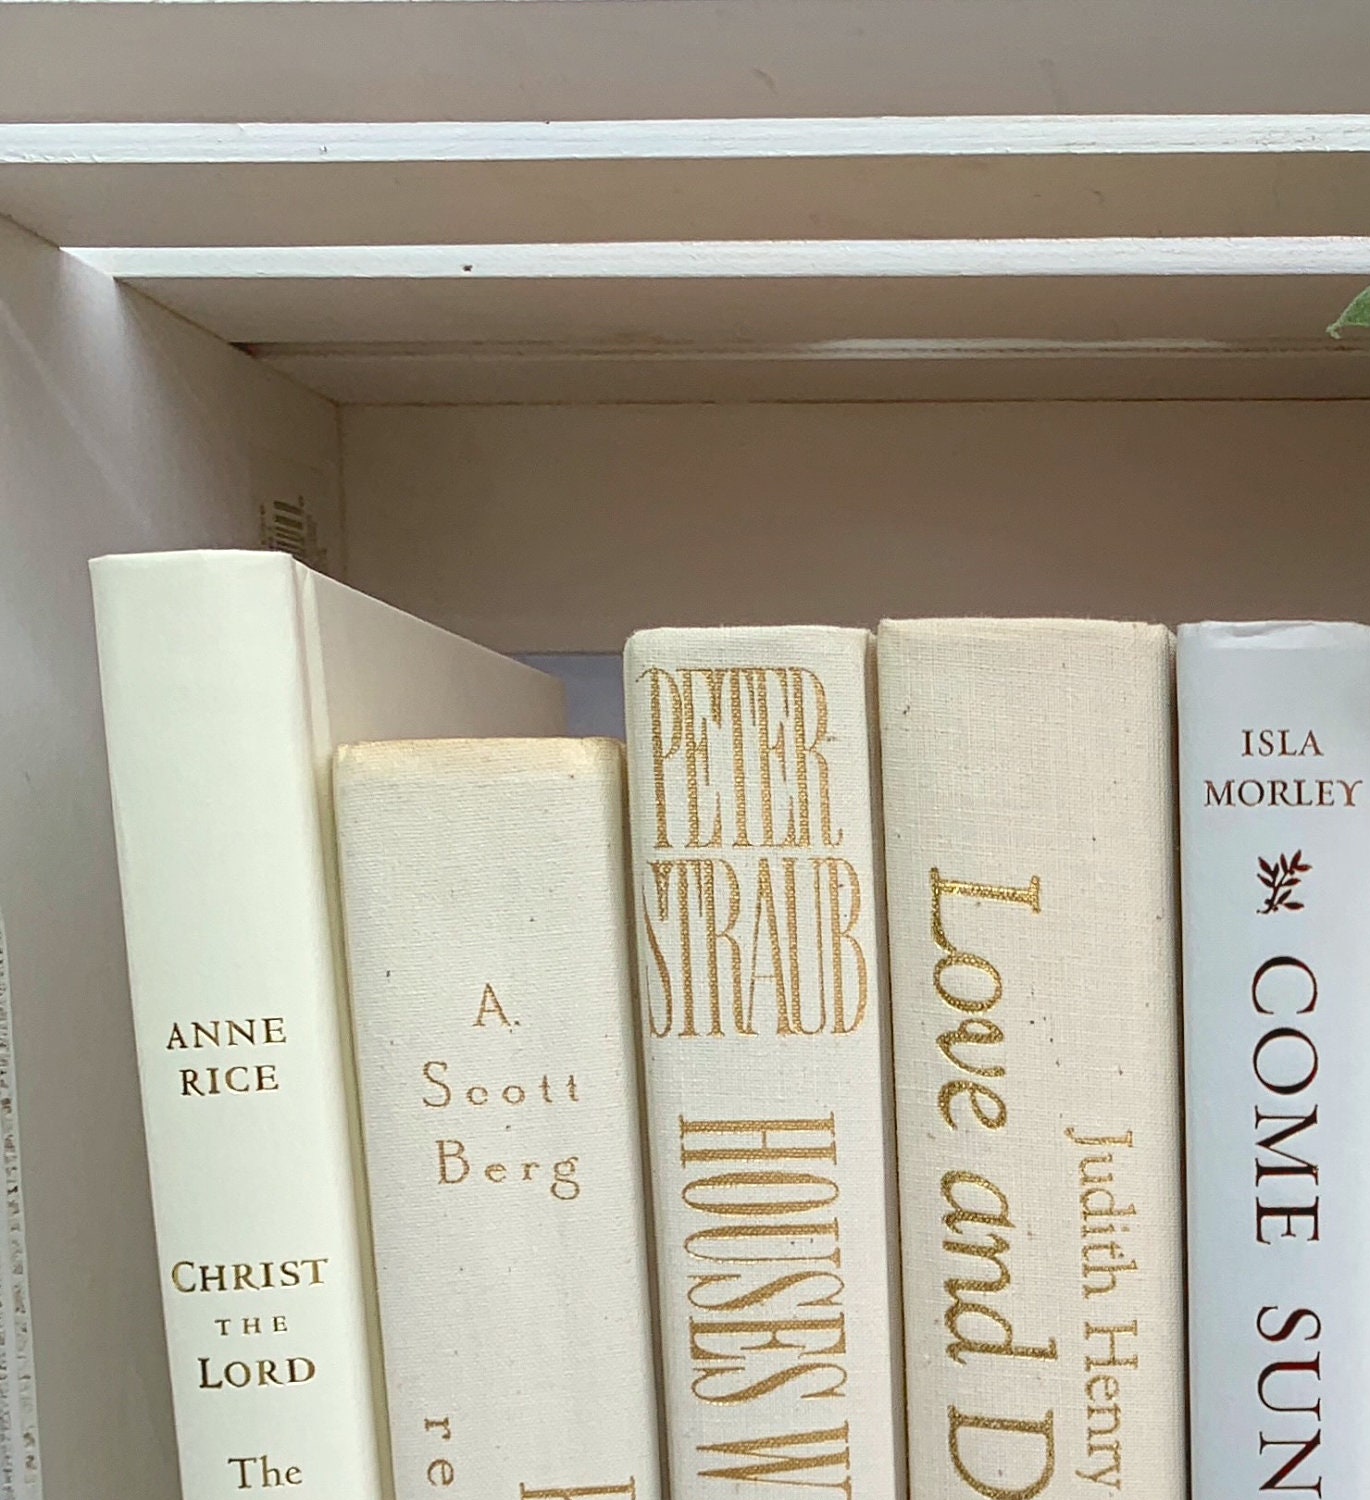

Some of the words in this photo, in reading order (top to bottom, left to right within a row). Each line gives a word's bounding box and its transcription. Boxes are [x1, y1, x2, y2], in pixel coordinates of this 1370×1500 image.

[636, 667, 843, 849] PETER
[1241, 729, 1324, 757] ISLA
[1204, 779, 1362, 807] MORLEY
[642, 858, 868, 1038] STRAUB
[475, 983, 520, 1027] A.
[930, 867, 1041, 1131] Love
[166, 1017, 287, 1050] ANNE
[180, 1066, 279, 1096] RICE
[422, 1061, 582, 1108] Scott
[1251, 956, 1320, 1244] COME
[436, 1140, 581, 1199] Berg
[1064, 1126, 1138, 1298] Judith
[171, 1258, 328, 1293] CHRIST
[679, 1111, 848, 1406] HOUSES
[940, 1170, 1058, 1365] and
[216, 1317, 288, 1335] THE
[199, 1357, 315, 1388] LORD
[1077, 1320, 1139, 1490] Henry
[228, 1457, 303, 1488] The
